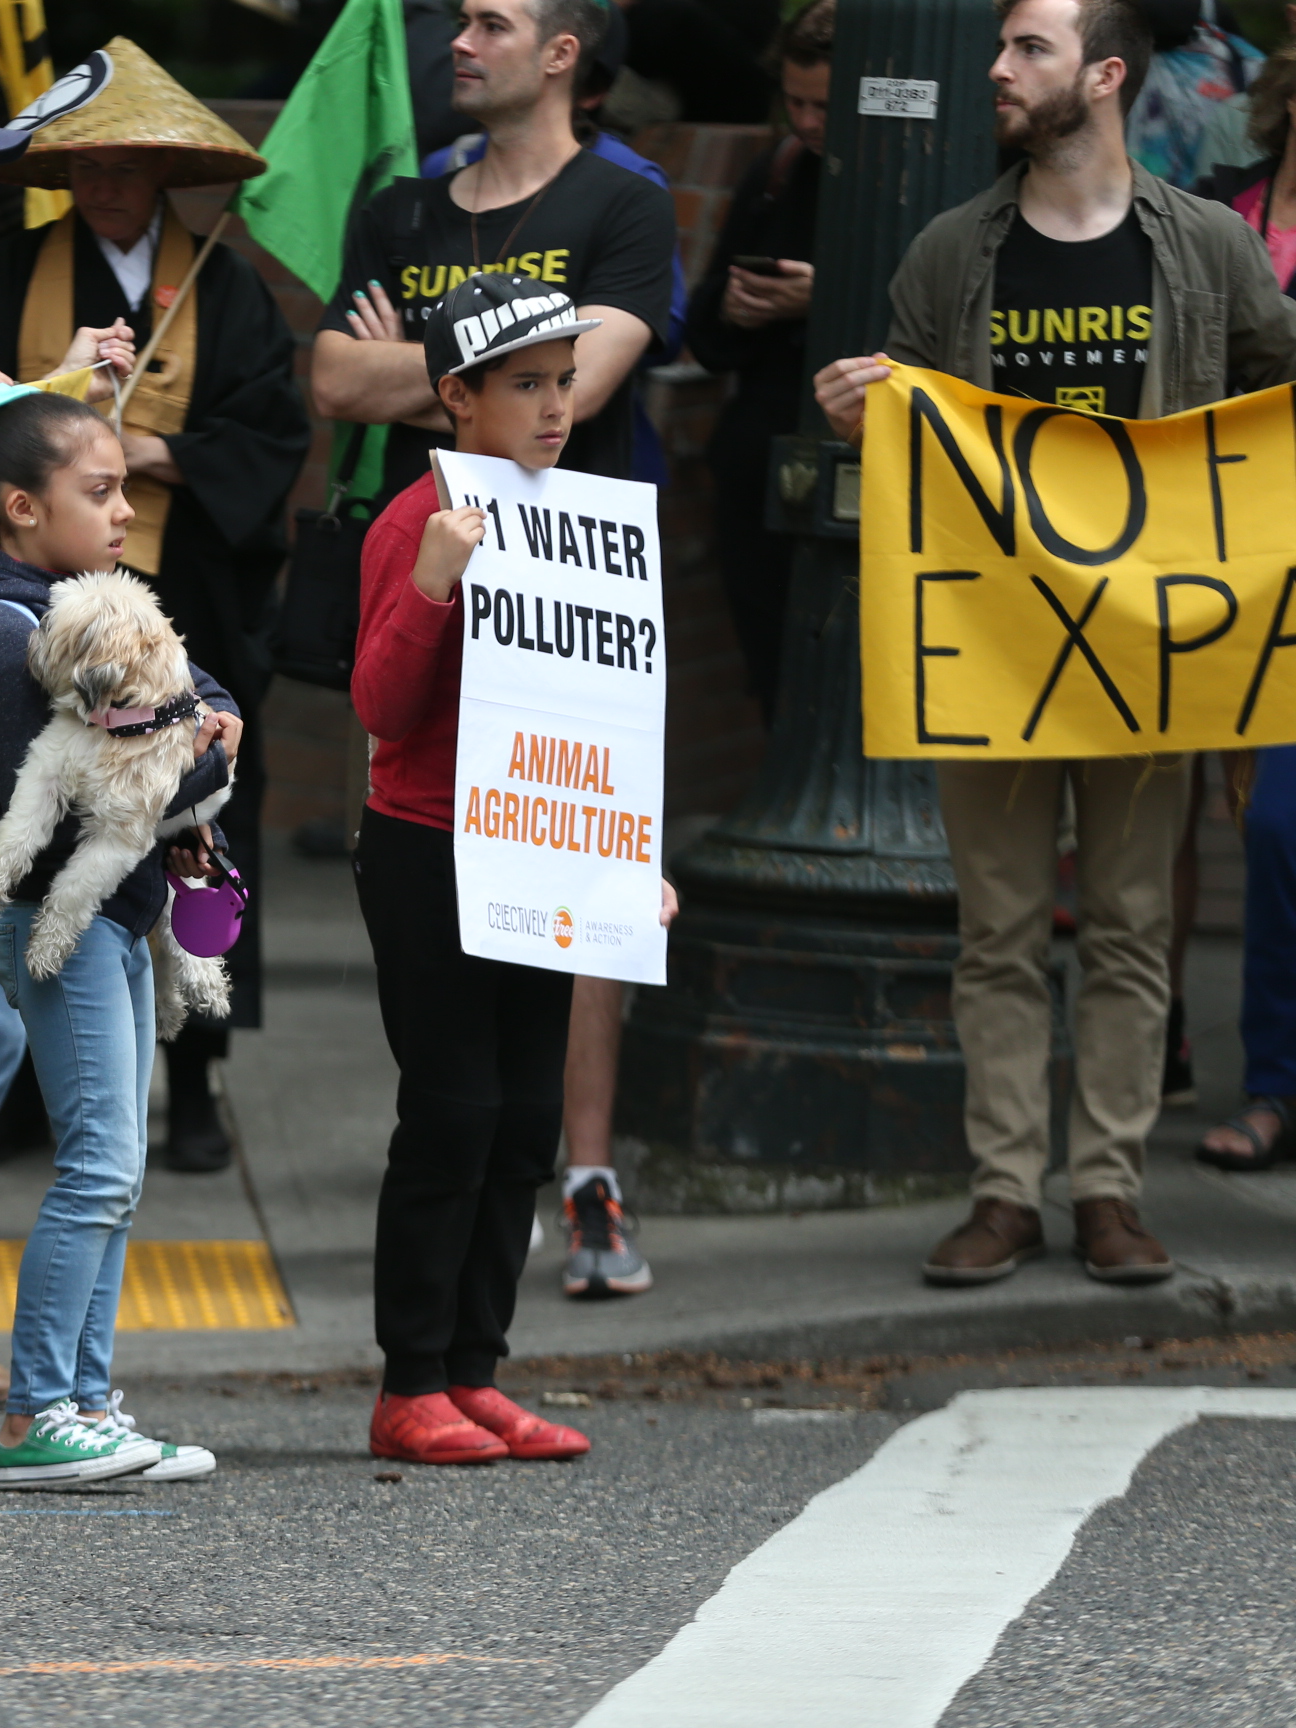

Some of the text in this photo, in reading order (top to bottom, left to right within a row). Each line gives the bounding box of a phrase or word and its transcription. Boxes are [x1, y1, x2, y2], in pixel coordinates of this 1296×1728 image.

[401, 248, 571, 299] SUNISE
[910, 385, 1147, 566] NO
[517, 503, 649, 581] WATER
[470, 583, 657, 674] POLLUTER?
[507, 731, 615, 796] ANIMAL
[464, 786, 652, 863] AGRICULTURE
[585, 920, 634, 937] AWARENESS
[585, 935, 622, 946] & ACTION
